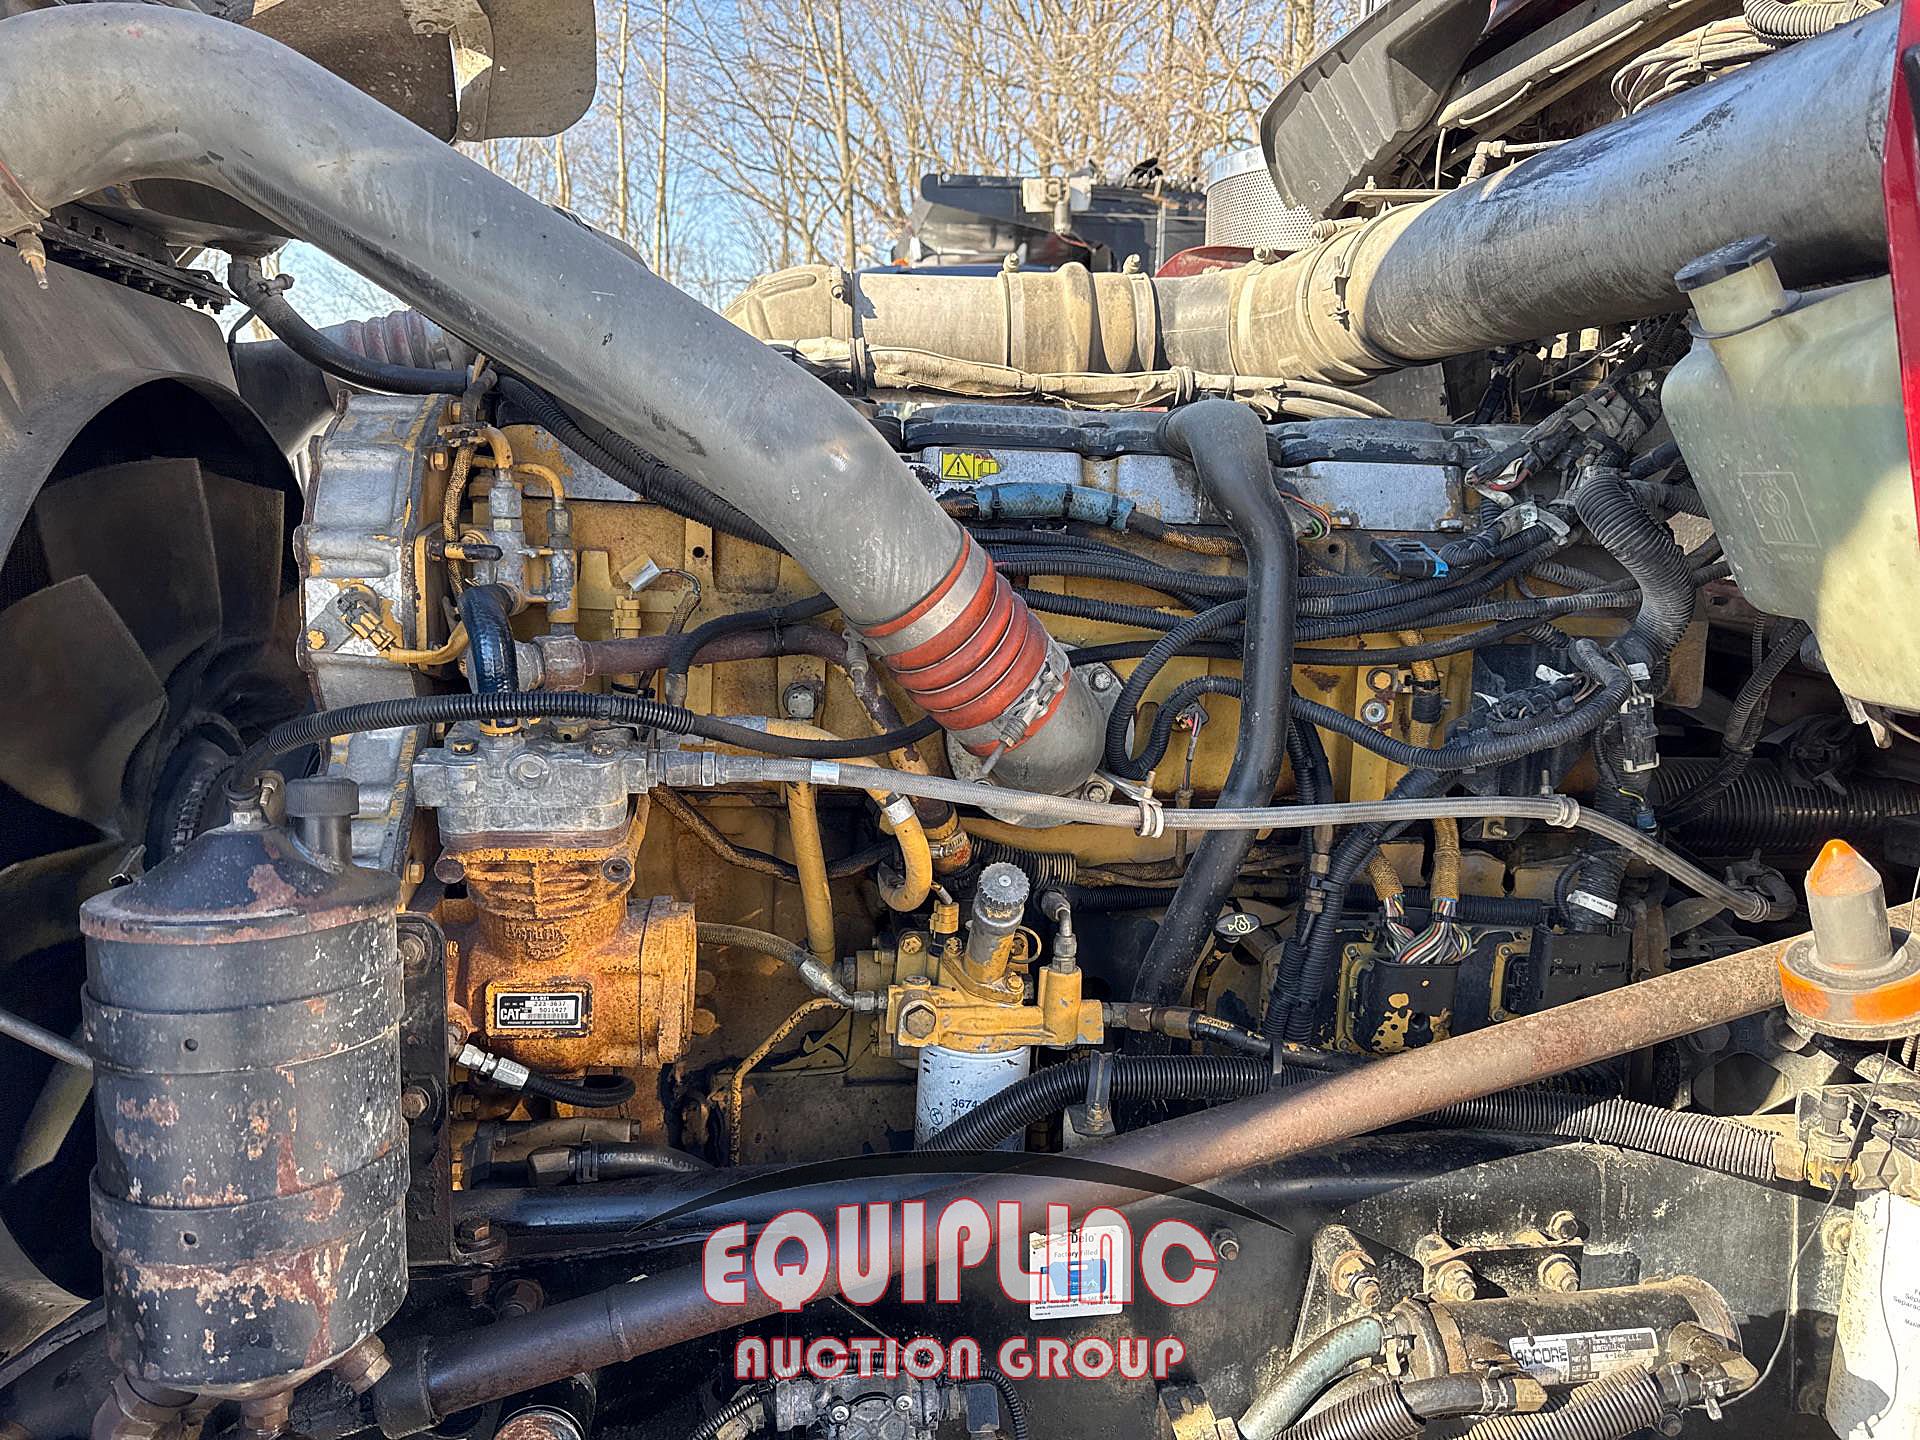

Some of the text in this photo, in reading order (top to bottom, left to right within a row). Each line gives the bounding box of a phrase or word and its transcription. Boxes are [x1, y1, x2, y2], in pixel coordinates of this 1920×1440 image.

[500, 1008, 520, 1021] CAT
[1071, 1233, 1095, 1244] Delo
[1054, 1250, 1079, 1258] Factory
